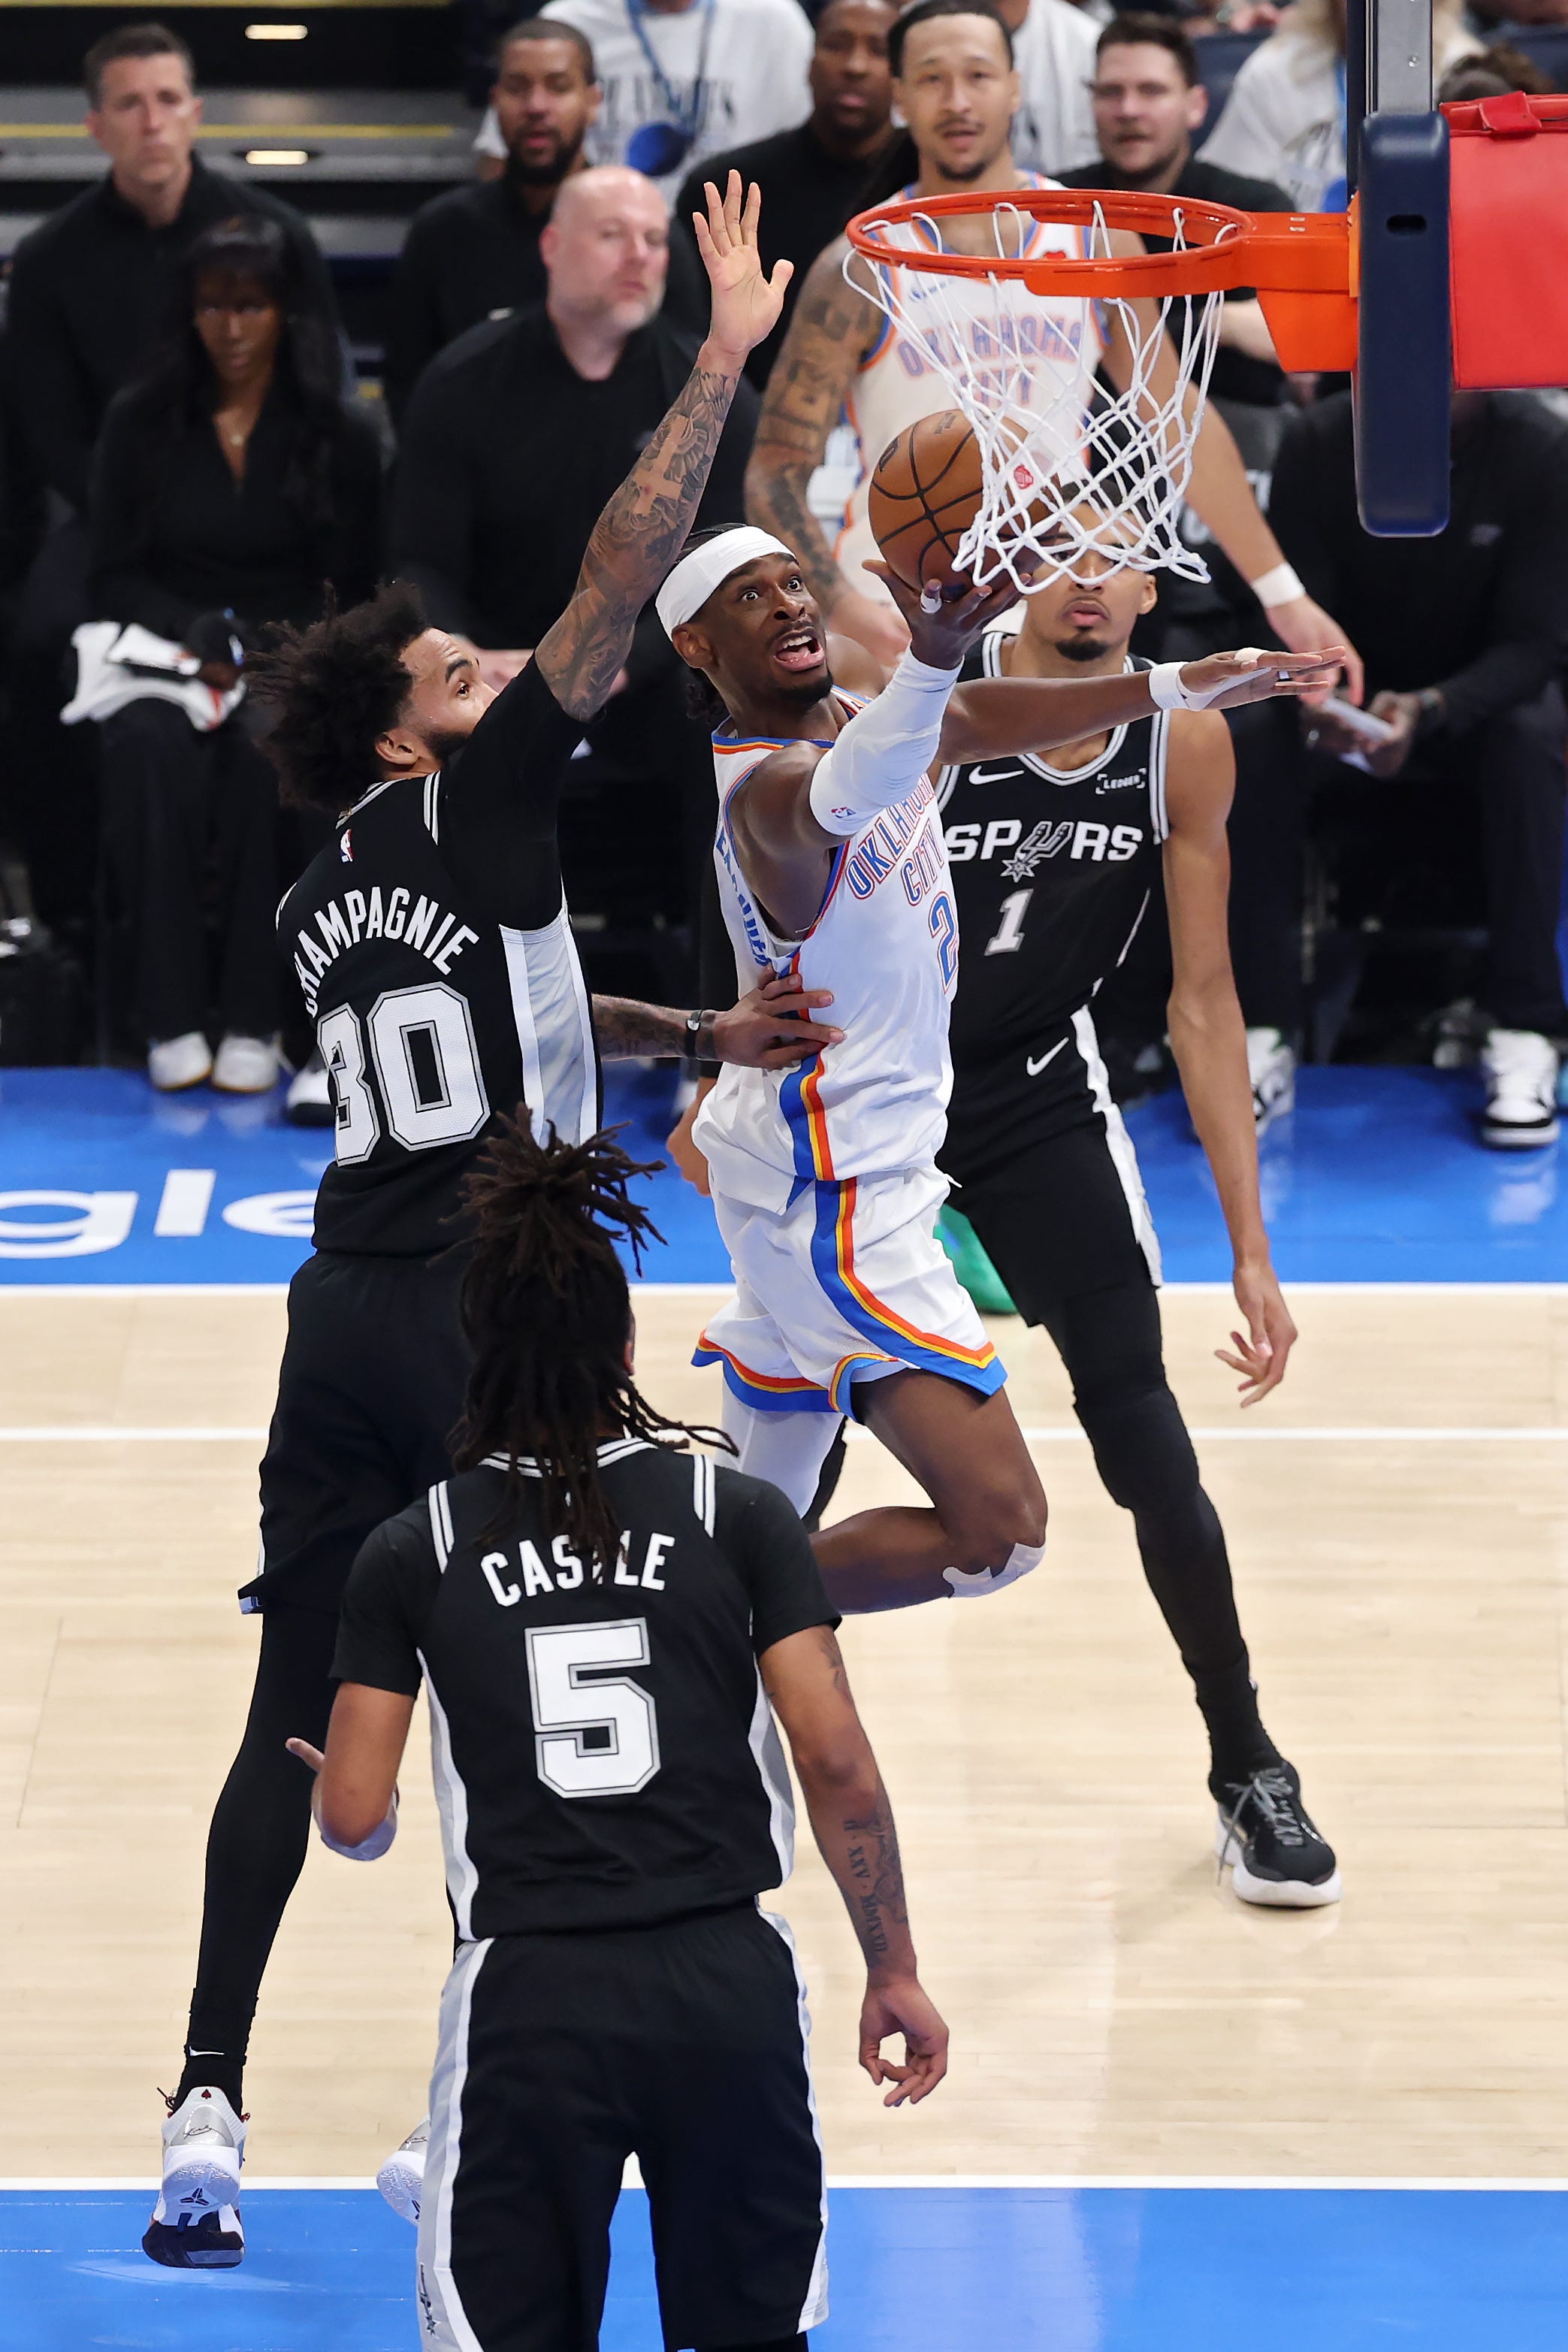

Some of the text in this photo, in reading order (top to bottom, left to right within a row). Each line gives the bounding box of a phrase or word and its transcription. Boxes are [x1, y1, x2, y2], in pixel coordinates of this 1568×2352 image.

[902, 818, 944, 905] CITY
[945, 820, 1144, 883] SPURS
[929, 891, 959, 994] 2
[984, 888, 1034, 957] 1
[317, 981, 491, 1167] 30
[480, 1530, 675, 1607] CASLE
[524, 1616, 661, 1798] 5
